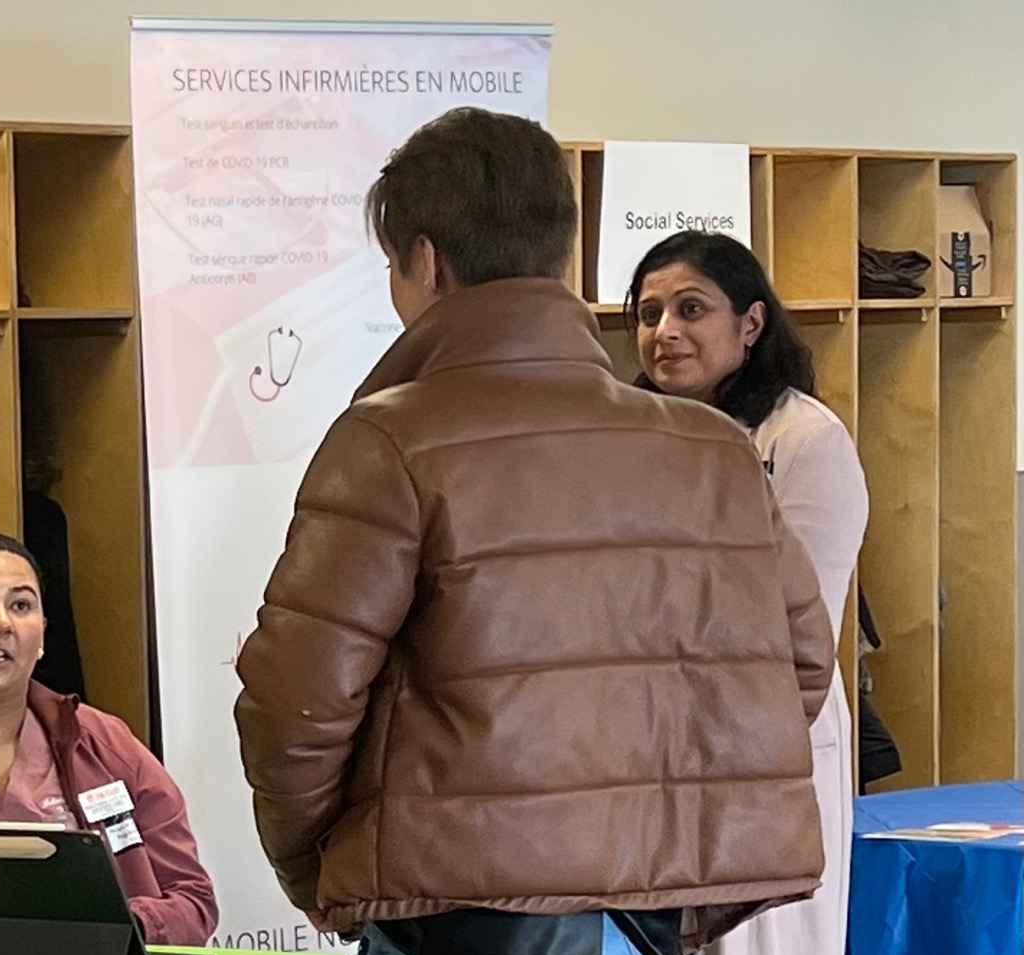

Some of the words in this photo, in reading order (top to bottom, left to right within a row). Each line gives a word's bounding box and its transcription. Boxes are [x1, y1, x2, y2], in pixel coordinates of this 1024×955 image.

[173, 68, 272, 93] SERVICES
[279, 64, 409, 93] INFIRMIÈRES
[416, 70, 442, 93] EN
[450, 71, 523, 93] MOBILE
[181, 117, 201, 130] Test
[204, 118, 243, 133] sanguin
[245, 119, 254, 130] et
[256, 118, 274, 130] test
[182, 156, 203, 169] Test
[206, 156, 219, 169] de
[222, 156, 268, 169] COVID-19
[270, 156, 289, 169] PCR
[185, 195, 206, 208] Test
[209, 194, 234, 207] nasal
[236, 194, 265, 209] rapide
[268, 194, 280, 207] de
[186, 214, 200, 228] 19
[625, 211, 671, 230] Social
[675, 211, 734, 230] Services
[187, 252, 210, 266] Test
[249, 253, 279, 267] rapide
[189, 272, 236, 287] Anticorps
[212, 924, 309, 952] MOBILE
